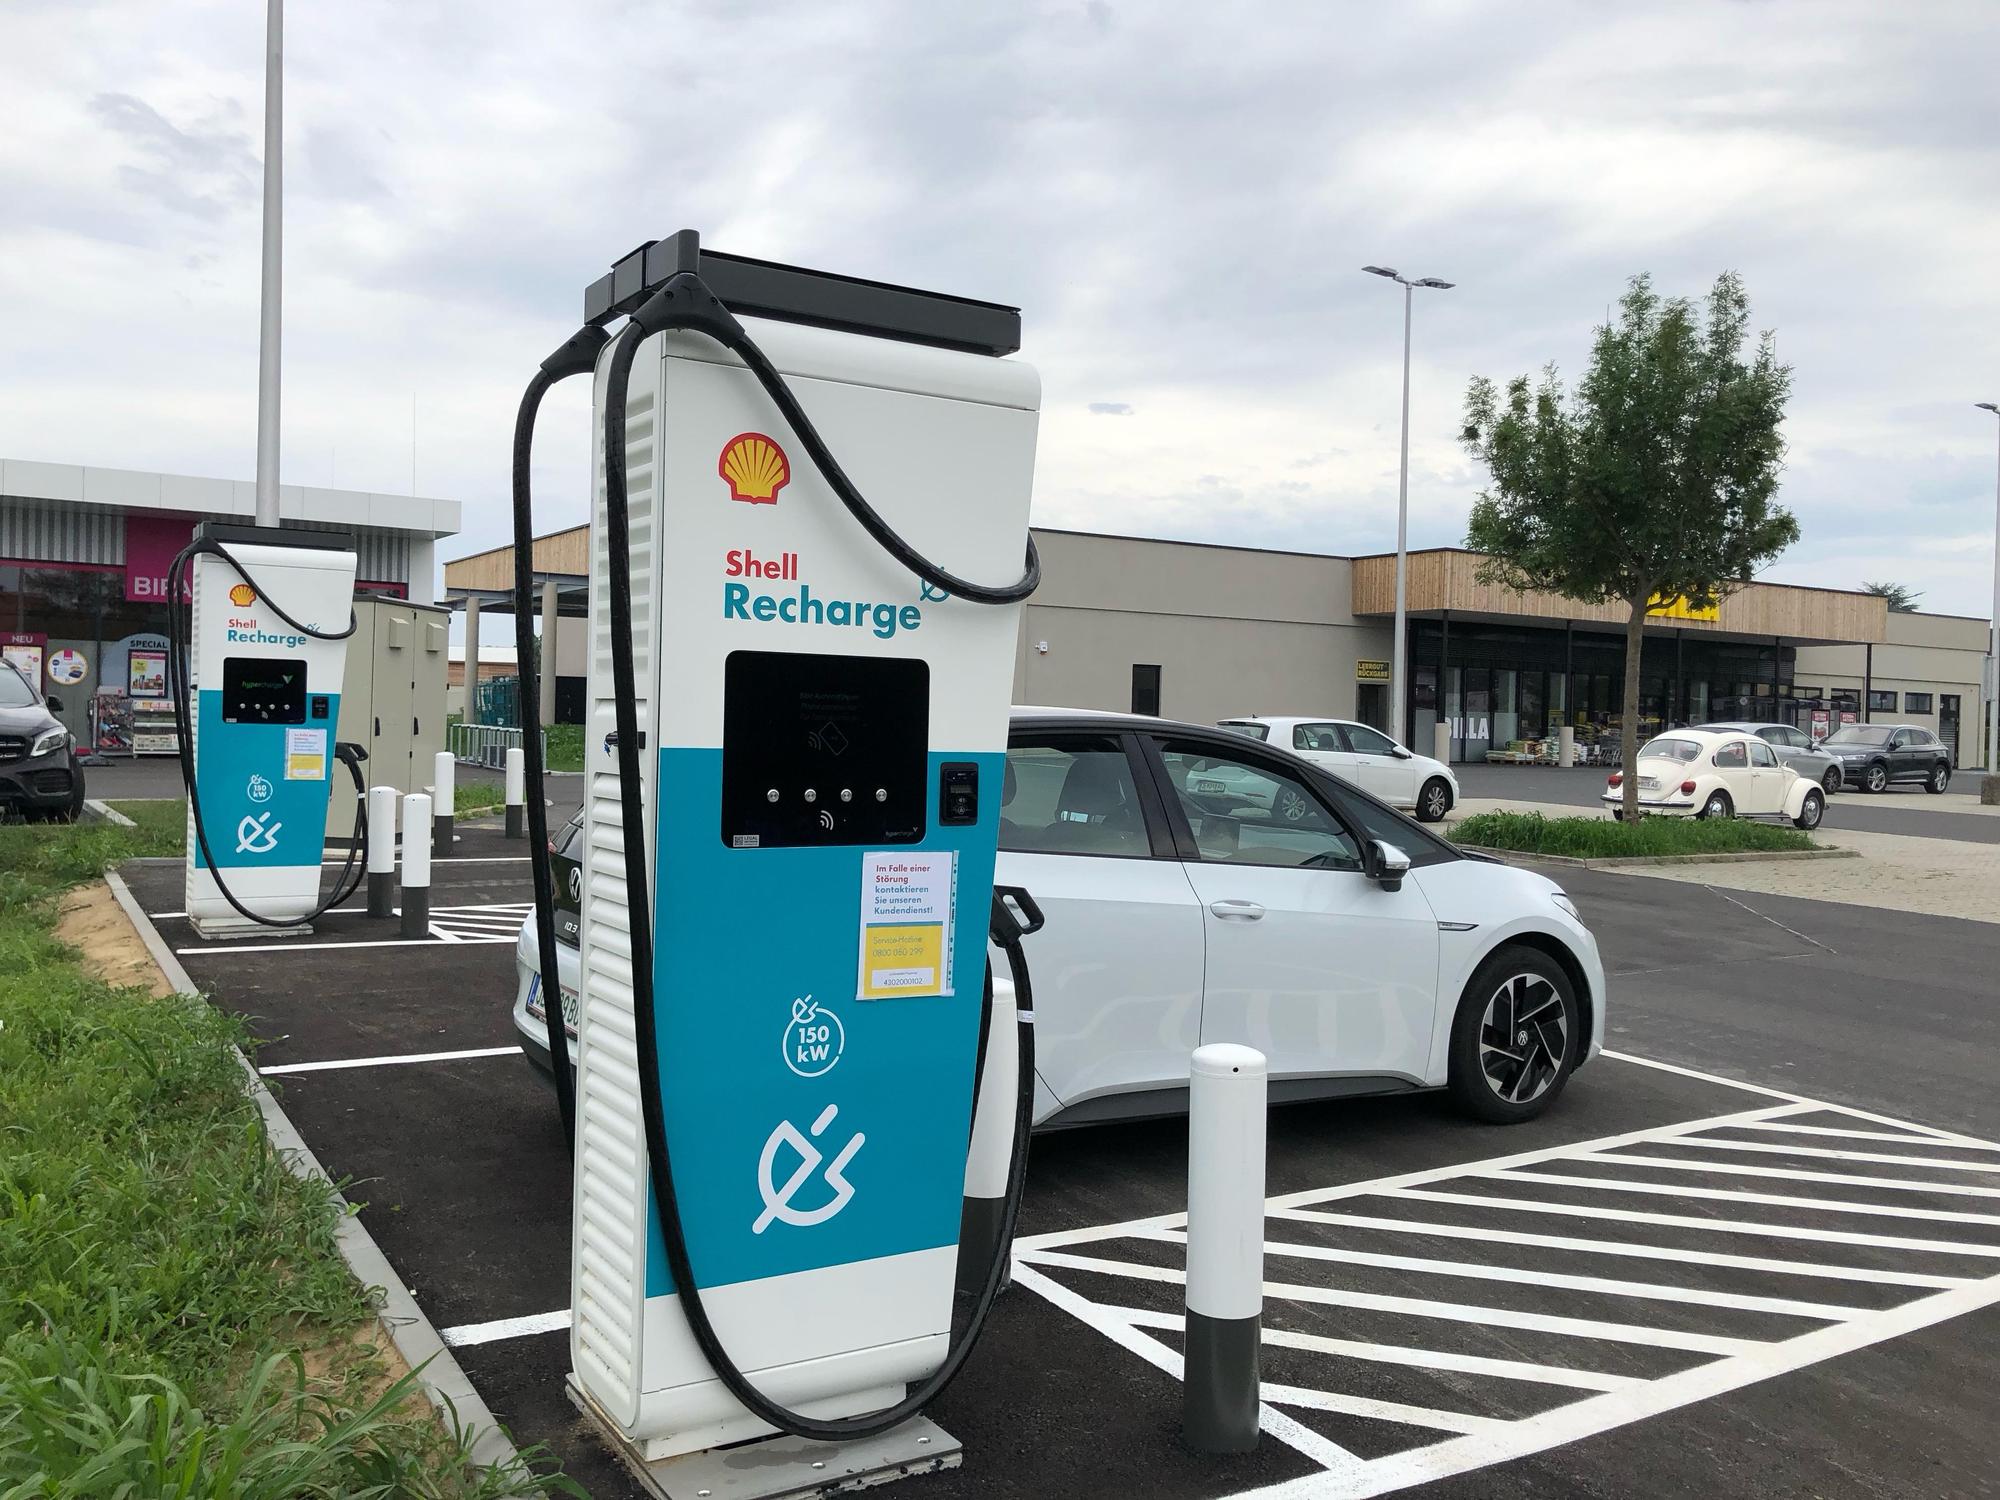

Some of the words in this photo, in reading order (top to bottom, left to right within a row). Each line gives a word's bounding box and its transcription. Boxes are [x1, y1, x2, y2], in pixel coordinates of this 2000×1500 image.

[725, 549, 798, 580] Shell
[724, 582, 921, 639] Recharge
[228, 618, 257, 629] Shell
[11, 634, 33, 643] NEU
[227, 629, 307, 648] Recharge
[130, 640, 168, 649] SPECIAL
[876, 864, 887, 873] Im
[888, 864, 908, 873] Falle
[909, 864, 931, 873] einer
[875, 875, 909, 885] Störung
[875, 885, 929, 894] kontaktieren
[874, 896, 887, 904] Sie
[874, 906, 933, 915] Kundendienst!
[798, 1025, 830, 1044] 150
[797, 1044, 830, 1063] kW
